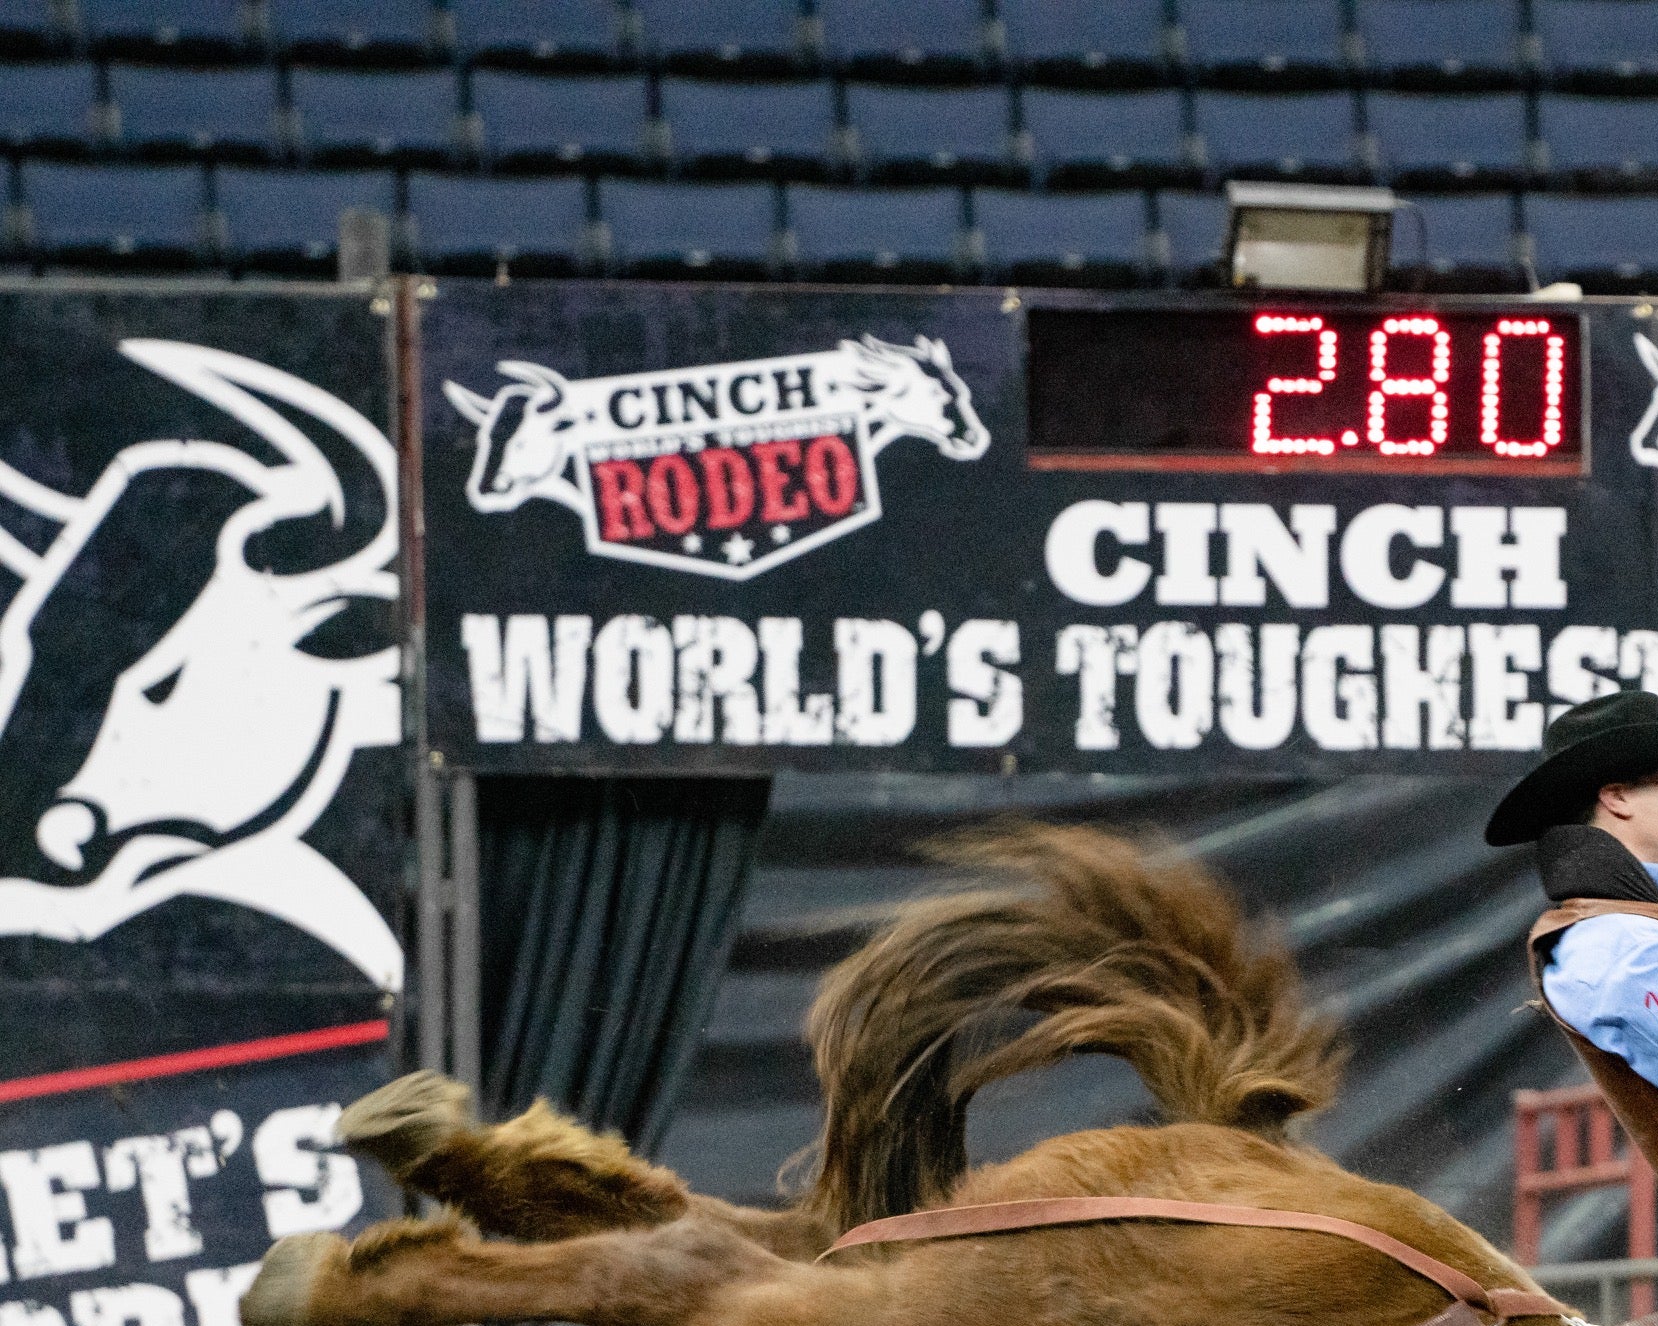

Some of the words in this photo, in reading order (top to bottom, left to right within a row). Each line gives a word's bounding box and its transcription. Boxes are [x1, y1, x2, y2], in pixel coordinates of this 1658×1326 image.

[608, 366, 818, 429] CINCH
[1252, 315, 1563, 457] 2.80
[592, 433, 858, 543] RODEO
[1044, 500, 1568, 609] CINCH
[461, 609, 1024, 748] WORLD'S
[0, 1102, 363, 1286] ET'S
